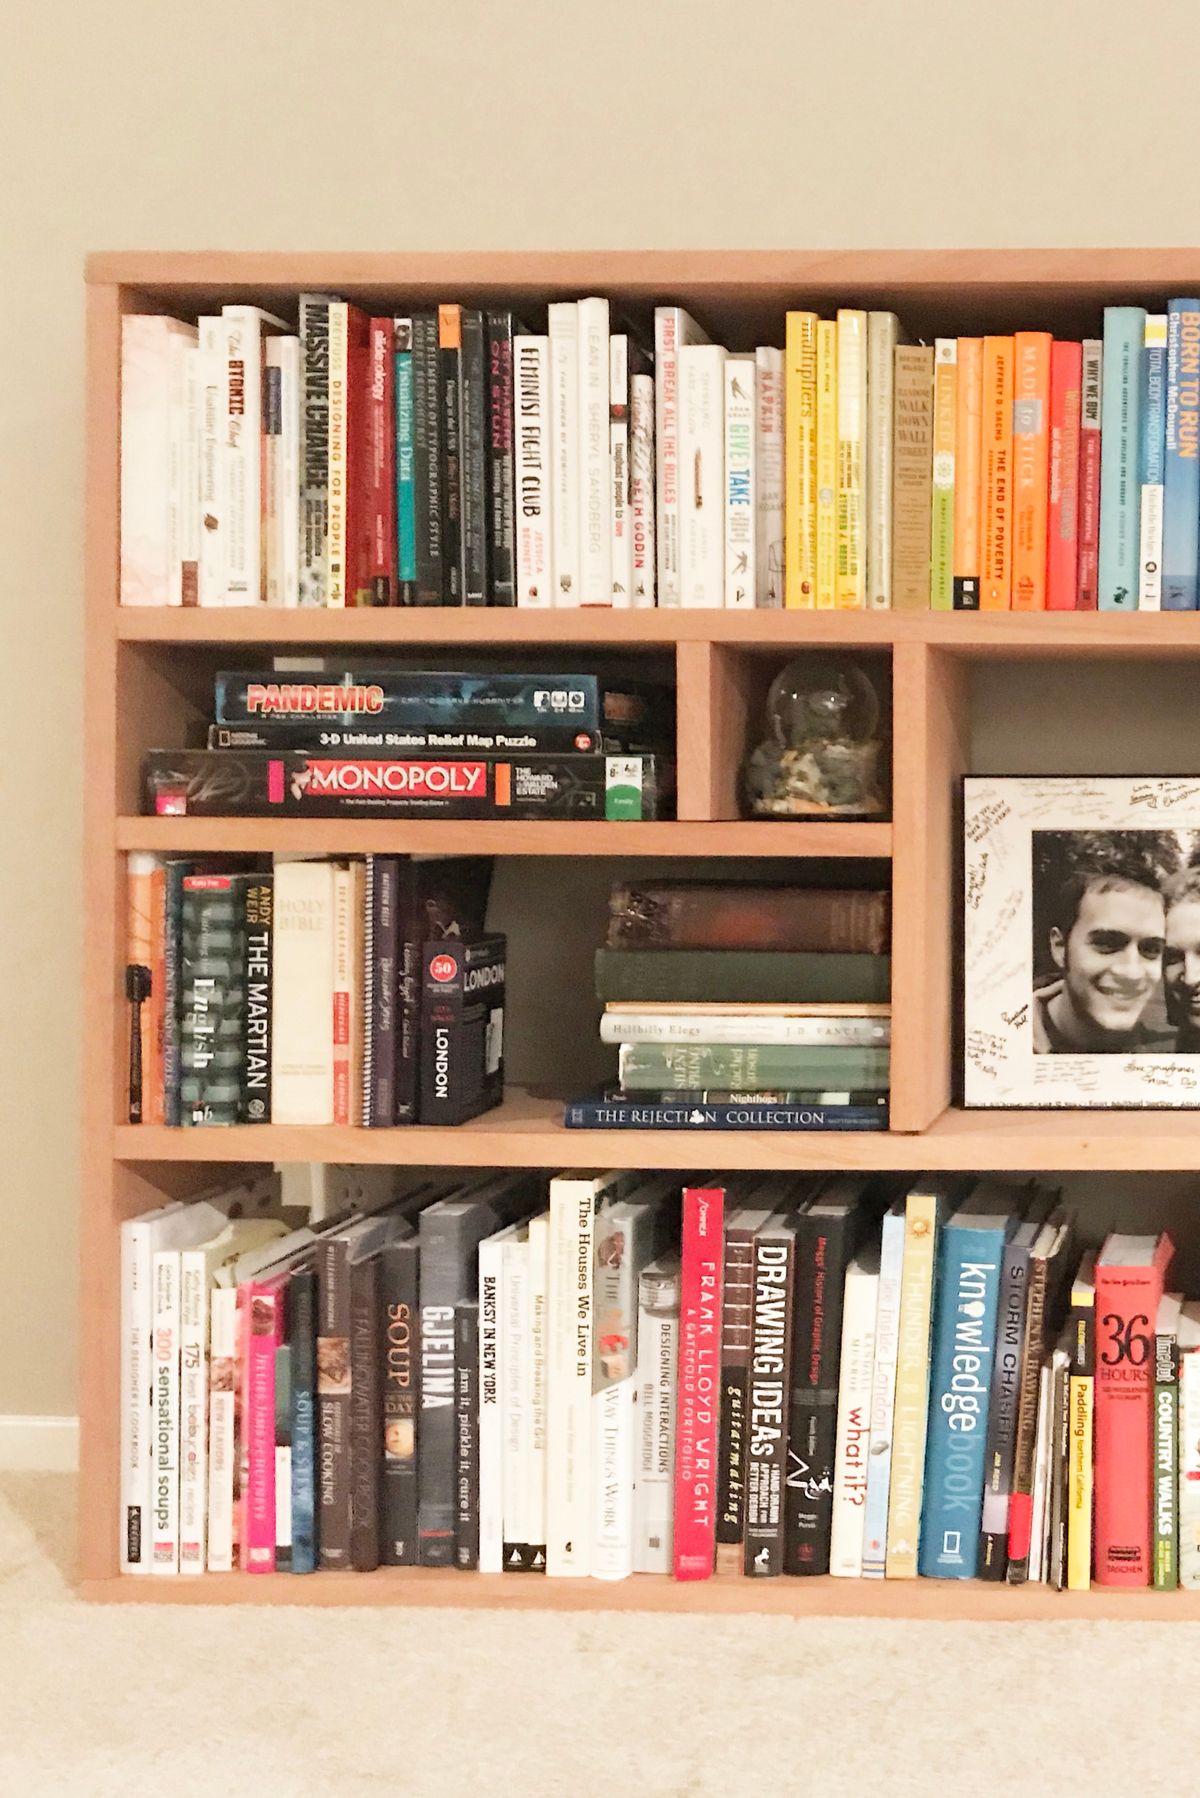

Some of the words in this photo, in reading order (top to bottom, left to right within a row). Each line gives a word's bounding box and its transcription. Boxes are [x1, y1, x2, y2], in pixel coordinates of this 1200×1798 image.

[228, 335, 243, 357] The
[415, 320, 425, 364] ROBERT
[427, 320, 436, 342] THE
[588, 326, 598, 366] LEAN
[663, 318, 675, 355] FIRST,
[1166, 312, 1179, 383] Christopher
[1181, 312, 1200, 373] BORN
[306, 304, 329, 400] MASSIVE
[1087, 360, 1098, 382] WHY
[229, 360, 244, 415] ATOMIC
[427, 346, 437, 407] ELEMENTS
[520, 348, 540, 417] FEMINIST
[589, 372, 598, 387] IN
[664, 360, 675, 404] BREAK
[995, 355, 1004, 395] JEFFREY
[1087, 385, 1097, 398] WE
[1180, 378, 1199, 405] TO
[332, 380, 341, 461] DESIGNING
[398, 360, 413, 442] Visualizing
[416, 368, 426, 448] BRINGHURST
[428, 411, 438, 427] OF
[664, 408, 675, 430] ALL
[1085, 402, 1097, 420] BUY
[1166, 386, 1178, 449] McDougall
[227, 420, 241, 448] Chef
[588, 403, 599, 461] SHERYL
[664, 435, 675, 458] THE
[729, 424, 750, 458] GIVE
[995, 412, 1003, 441] SACHS
[1179, 411, 1199, 458] RUN
[306, 405, 329, 490] CHANGE
[400, 447, 413, 481] Data
[521, 426, 541, 470] FIGHT
[613, 443, 624, 478] toughest
[997, 450, 1006, 473] THE
[332, 470, 341, 496] FOR
[428, 431, 439, 516] TYPOGRAPHIC
[665, 463, 675, 504] RULES
[730, 469, 750, 505] TAKE
[996, 478, 1006, 501] END
[522, 476, 541, 517] CLUB
[589, 468, 600, 553] SANDBERG
[613, 481, 624, 508] people
[615, 510, 623, 519] to
[634, 479, 643, 516] SETH
[996, 508, 1005, 521] OF
[331, 505, 341, 556] PEOPLE
[430, 521, 439, 558] STYLE
[615, 521, 624, 537] love
[635, 522, 644, 568] GODIN
[523, 528, 531, 576] BENNETT
[535, 531, 543, 573] JESSICA
[995, 527, 1004, 580] POVERTY
[247, 684, 384, 713] PANDEMIC
[320, 733, 340, 745] 3-D
[343, 733, 383, 745] United
[386, 733, 425, 745] States
[428, 735, 465, 746] Relief
[467, 735, 493, 748] Map
[496, 735, 536, 747] Puzzle
[312, 765, 481, 792] MONOPOLY
[247, 888, 258, 923] WEIR
[259, 886, 271, 924] ANDY
[248, 932, 268, 976] THE
[436, 962, 451, 973] 50
[190, 978, 215, 1068] English
[248, 983, 268, 1088] MARTIAN
[435, 1028, 448, 1098] LONDON
[596, 1110, 625, 1123] THE
[726, 1111, 824, 1124] COLLECTION
[730, 1094, 778, 1104] Nighthogs
[578, 1199, 591, 1228] The
[577, 1234, 590, 1290] Houses
[484, 1277, 496, 1323] BANKSY
[577, 1295, 590, 1319] We
[699, 1262, 715, 1335] FRANK
[753, 1246, 787, 1374] DRAWING
[1005, 1266, 1025, 1345] STORM
[156, 1328, 172, 1360] 300
[387, 1303, 409, 1387] SOUP
[484, 1328, 496, 1339] IN
[576, 1325, 590, 1357] Live
[1101, 1314, 1149, 1366] 36
[185, 1342, 199, 1368] 175
[421, 1306, 454, 1408] GJELINA
[484, 1343, 496, 1370] NEW
[576, 1361, 589, 1377] in
[660, 1324, 671, 1387] DESIGNING
[1101, 1369, 1148, 1381] HOURS
[458, 1367, 471, 1393] jam
[484, 1374, 496, 1404] YORK
[697, 1350, 712, 1423] LLOYD
[998, 1353, 1017, 1446] CHASER
[157, 1366, 174, 1470] sensational
[459, 1397, 471, 1409] it,
[1074, 1384, 1088, 1436] Paddling
[458, 1414, 472, 1456] pickle
[658, 1391, 670, 1473] INTERACTIONS
[846, 1408, 871, 1467] what
[1158, 1392, 1172, 1472] COUNTRY
[458, 1460, 471, 1473] it,
[724, 1386, 744, 1524] guitarmaking
[459, 1477, 470, 1508] cure
[694, 1438, 710, 1527] WRIGHT
[844, 1475, 867, 1505] if?
[155, 1476, 174, 1530] soups
[460, 1512, 471, 1521] it
[1158, 1476, 1172, 1535] WALKS
